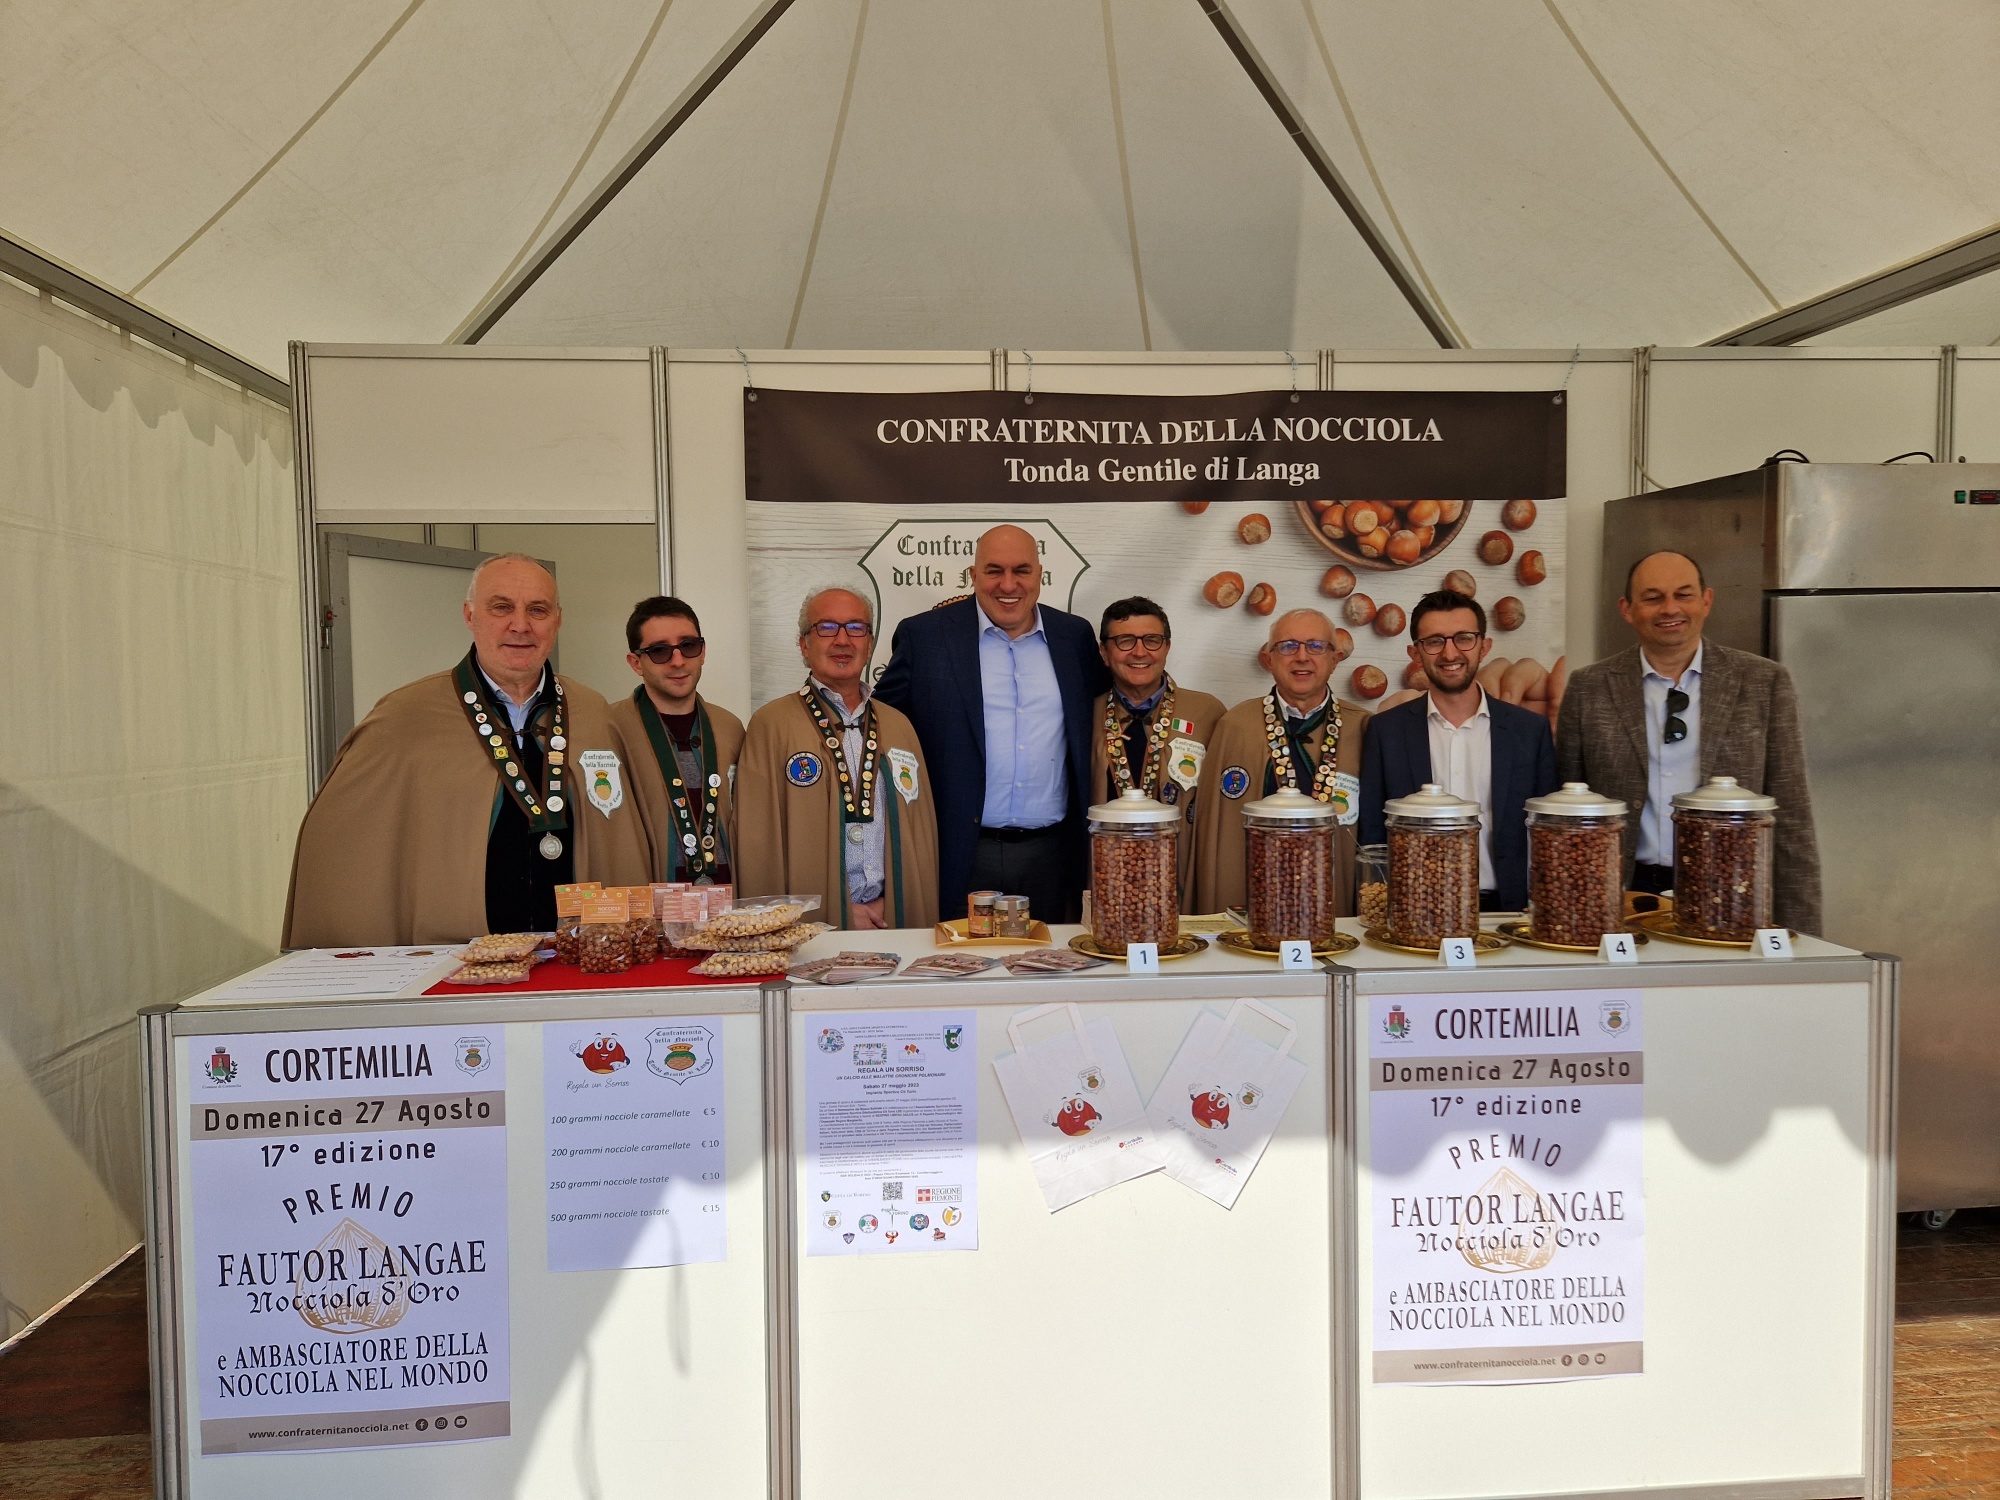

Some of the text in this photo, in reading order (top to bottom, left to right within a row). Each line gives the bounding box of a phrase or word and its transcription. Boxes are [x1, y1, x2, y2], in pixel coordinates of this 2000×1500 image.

[876, 417, 1444, 445] CONFRATERNITA DELLA NOCCIOLA
[1004, 456, 1321, 487] Tonda Gentile di Langa
[892, 565, 944, 587] della
[1291, 948, 1303, 963] 2
[1454, 945, 1465, 960] 3
[1616, 941, 1627, 955] 4
[1770, 936, 1781, 950] 5
[1139, 950, 1147, 965] 1
[1435, 1006, 1580, 1039] CORTEMILIA
[265, 1043, 433, 1083] CORTEMILIA
[1382, 1056, 1631, 1083] Domenica 27 Agosto
[204, 1097, 491, 1132] Domenica 27 Agosto
[551, 1107, 716, 1125] 100 grammi nocciole caramellate € 5
[1431, 1095, 1582, 1117] 17° edizione
[261, 1139, 436, 1168] 17° edizione
[551, 1139, 720, 1158] 200 grammi nocciole caramellate € 10
[1448, 1133, 1562, 1170] PREMIO
[550, 1171, 720, 1190] 250 grammi nocciole tostate € 10
[931, 1187, 961, 1195] REGIONE
[283, 1182, 414, 1224] PREMIO
[931, 1194, 961, 1202] PIEMONTE
[1391, 1191, 1626, 1228] FAUTOR LANGAE
[550, 1204, 720, 1223] 500 grammi nocciole tostate € 15
[1415, 1226, 1523, 1253] Nocciola
[217, 1240, 487, 1288] FAUTOR LANGAE
[246, 1283, 371, 1314] Nocciola
[1389, 1275, 1627, 1305] e AMBASCIATORE DELLA
[1389, 1301, 1626, 1331] NOCCIOLA NEL MONDO
[218, 1331, 489, 1371] e AMBASCIATORE DELLA
[1413, 1356, 1556, 1371] www.confraternitanocciola.net
[219, 1359, 488, 1398] NOCCIOLA NEL MONDO
[248, 1421, 409, 1440] www.confraternitanocciola.net
